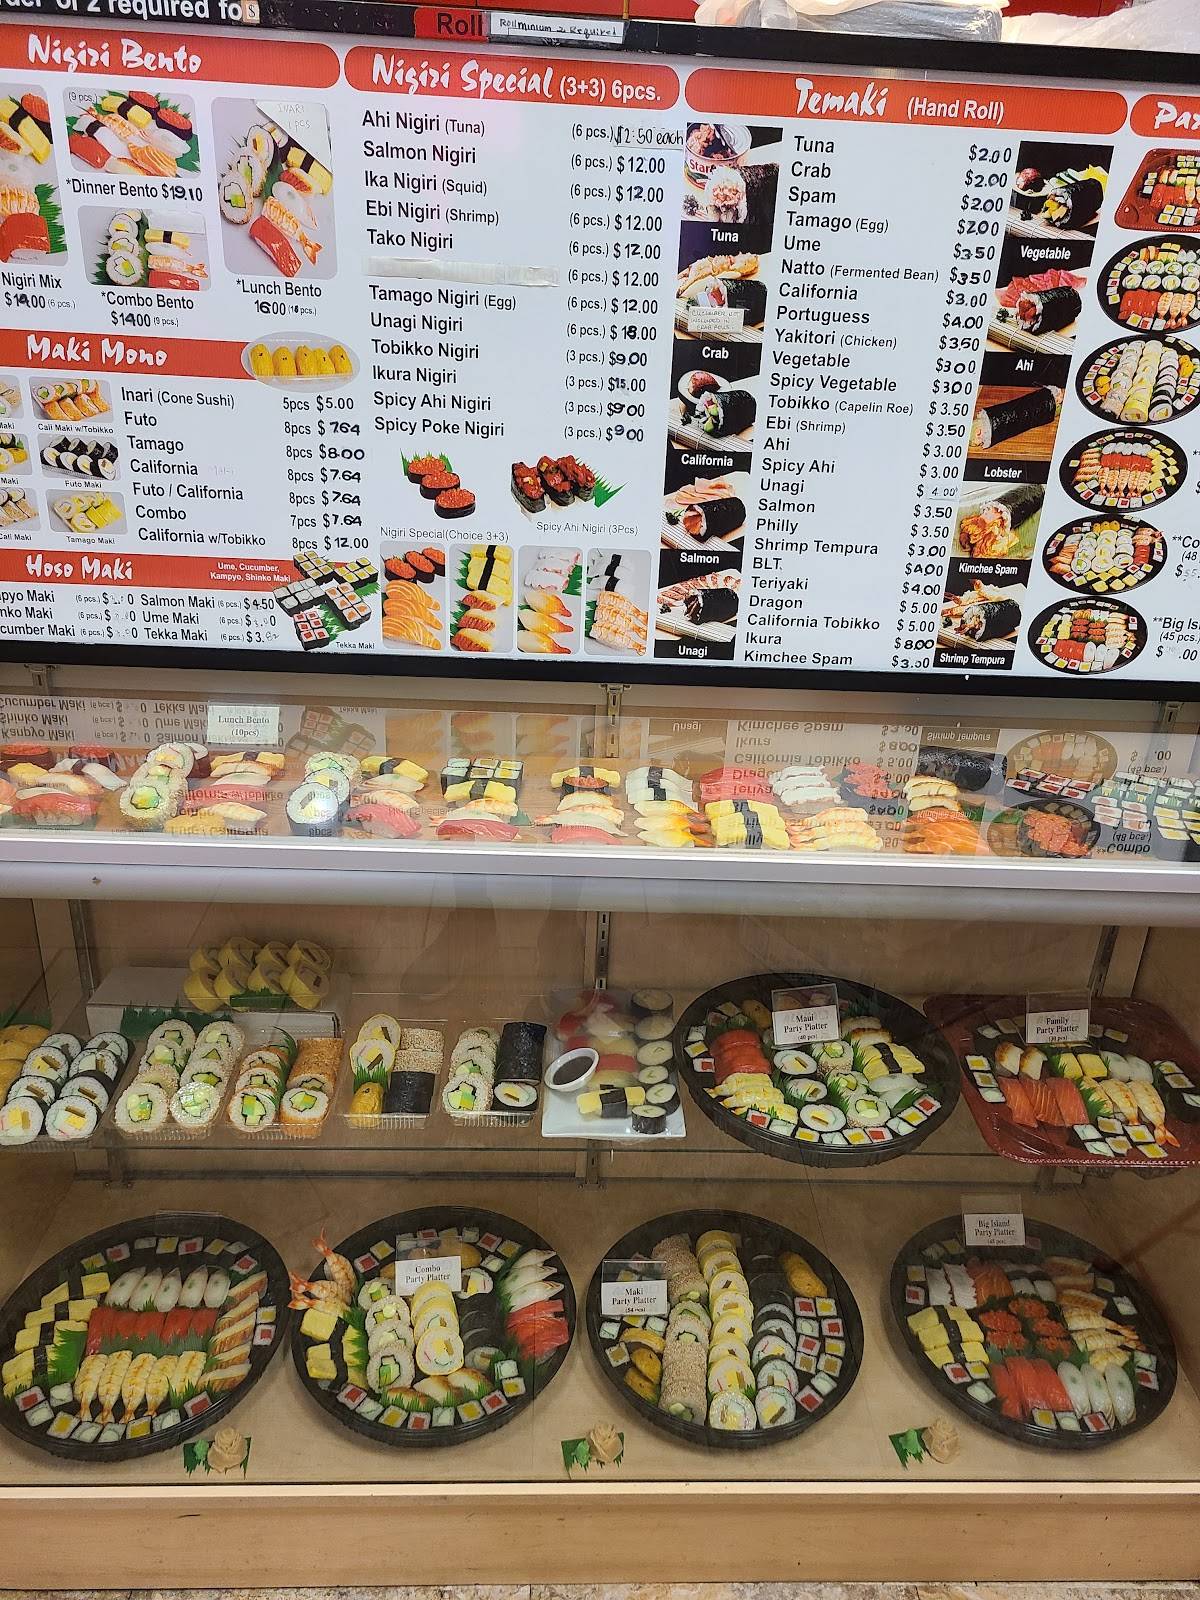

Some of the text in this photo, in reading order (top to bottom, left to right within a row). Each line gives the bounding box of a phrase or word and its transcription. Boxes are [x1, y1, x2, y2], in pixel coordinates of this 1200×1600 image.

[435, 12, 484, 37] Roll
[27, 33, 202, 73] Nigiri Bento
[371, 53, 660, 103] Nigiri Special (3+3) 6pcs.
[796, 78, 1003, 125] Temaki (Hand Roll)
[363, 110, 484, 137] Ahi Nigiri (Tuna)
[794, 136, 834, 153] Tuna
[364, 141, 475, 166] Salmon Nigiri
[792, 161, 830, 178] Crab
[119, 182, 157, 197] Bento
[365, 171, 486, 196] Ika Nigiri (Squid)
[789, 186, 835, 206] Spam
[367, 200, 498, 226] Ebi Nigiri (Shrimp)
[787, 211, 851, 232] Tamago
[856, 218, 888, 233] (Egg)
[367, 229, 452, 252] Tako Nigiri
[711, 229, 738, 242] Tuna
[785, 235, 820, 251] Ume
[1021, 245, 1070, 261] Vegetable
[782, 259, 938, 283] Natto (Fermented Bean)
[2, 272, 62, 290] Nigiri Mix
[285, 282, 321, 297] Bento
[369, 285, 515, 310] Tamago Nigiri (Egg)
[780, 283, 857, 300] California
[157, 294, 193, 309] Bento
[371, 312, 462, 334] Unagi Nigiri
[777, 306, 869, 325] Portuguess
[775, 328, 896, 350] Yakitori (Chicken)
[28, 334, 167, 366] Maki Mono
[371, 339, 478, 361] Tobikko Nigiri
[702, 346, 729, 359] Crab
[773, 351, 850, 369] Vegetable
[1015, 359, 1034, 371] Ahi
[373, 365, 456, 386] Ikura Nigiri
[770, 373, 896, 393] Spicy Vegetable
[122, 387, 234, 409] Inari (Cone Sushi)
[317, 395, 353, 413] $5.00
[374, 391, 490, 413] Spicy Ahi Nigiri
[769, 395, 913, 416] Tobikko (Capelin Roe)
[125, 411, 157, 426] Futo
[767, 416, 845, 434] Ebi (Shrimp)
[375, 417, 503, 439] Spicy Poke Nigiri
[127, 435, 183, 454] Tamago
[764, 437, 789, 450] Ahi
[131, 459, 198, 475] California
[681, 454, 733, 466] California
[762, 458, 835, 475] Spicy Ahi
[984, 466, 1022, 478] Lobster
[65, 480, 83, 488] Futo
[133, 482, 243, 500] Futo California
[761, 478, 804, 495] Unagi
[136, 505, 186, 520] Combo
[759, 498, 814, 512] Salmon
[380, 526, 509, 542] Nigiri Special(Choice 3+3)
[536, 522, 638, 536] Spicy Ahi Nigiri (3Pcs)
[757, 518, 798, 535] Philly
[66, 536, 115, 545] Tamago Maki
[139, 528, 265, 545] California w/Tobikko
[755, 538, 877, 556] Shrimp Tempura
[680, 552, 719, 563] Salmon
[26, 554, 132, 580] Hoso Maki
[959, 563, 1017, 576] Kimchee Spam
[752, 576, 807, 592] Teriyaki
[141, 594, 184, 607] Salmon
[188, 596, 214, 608] Maki
[750, 595, 802, 610] Dragon
[143, 611, 169, 623] Ume
[173, 612, 199, 624] Maki
[748, 614, 879, 629] California Tobikko
[144, 628, 177, 639] Tekka
[181, 629, 207, 641] Maki
[746, 632, 781, 644] Ikura
[358, 642, 375, 650] Maki
[679, 646, 707, 658] Unagi
[745, 650, 852, 667] Kimchee Spam
[940, 653, 1005, 666] Shrimp Tempura
[232, 729, 259, 737] (10pcs)
[784, 1025, 802, 1033] Party
[1036, 1026, 1054, 1034] Party
[415, 1265, 441, 1273] Combo
[405, 1275, 424, 1284] Party
[625, 1288, 643, 1296] Maki
[612, 1297, 630, 1306] Party
